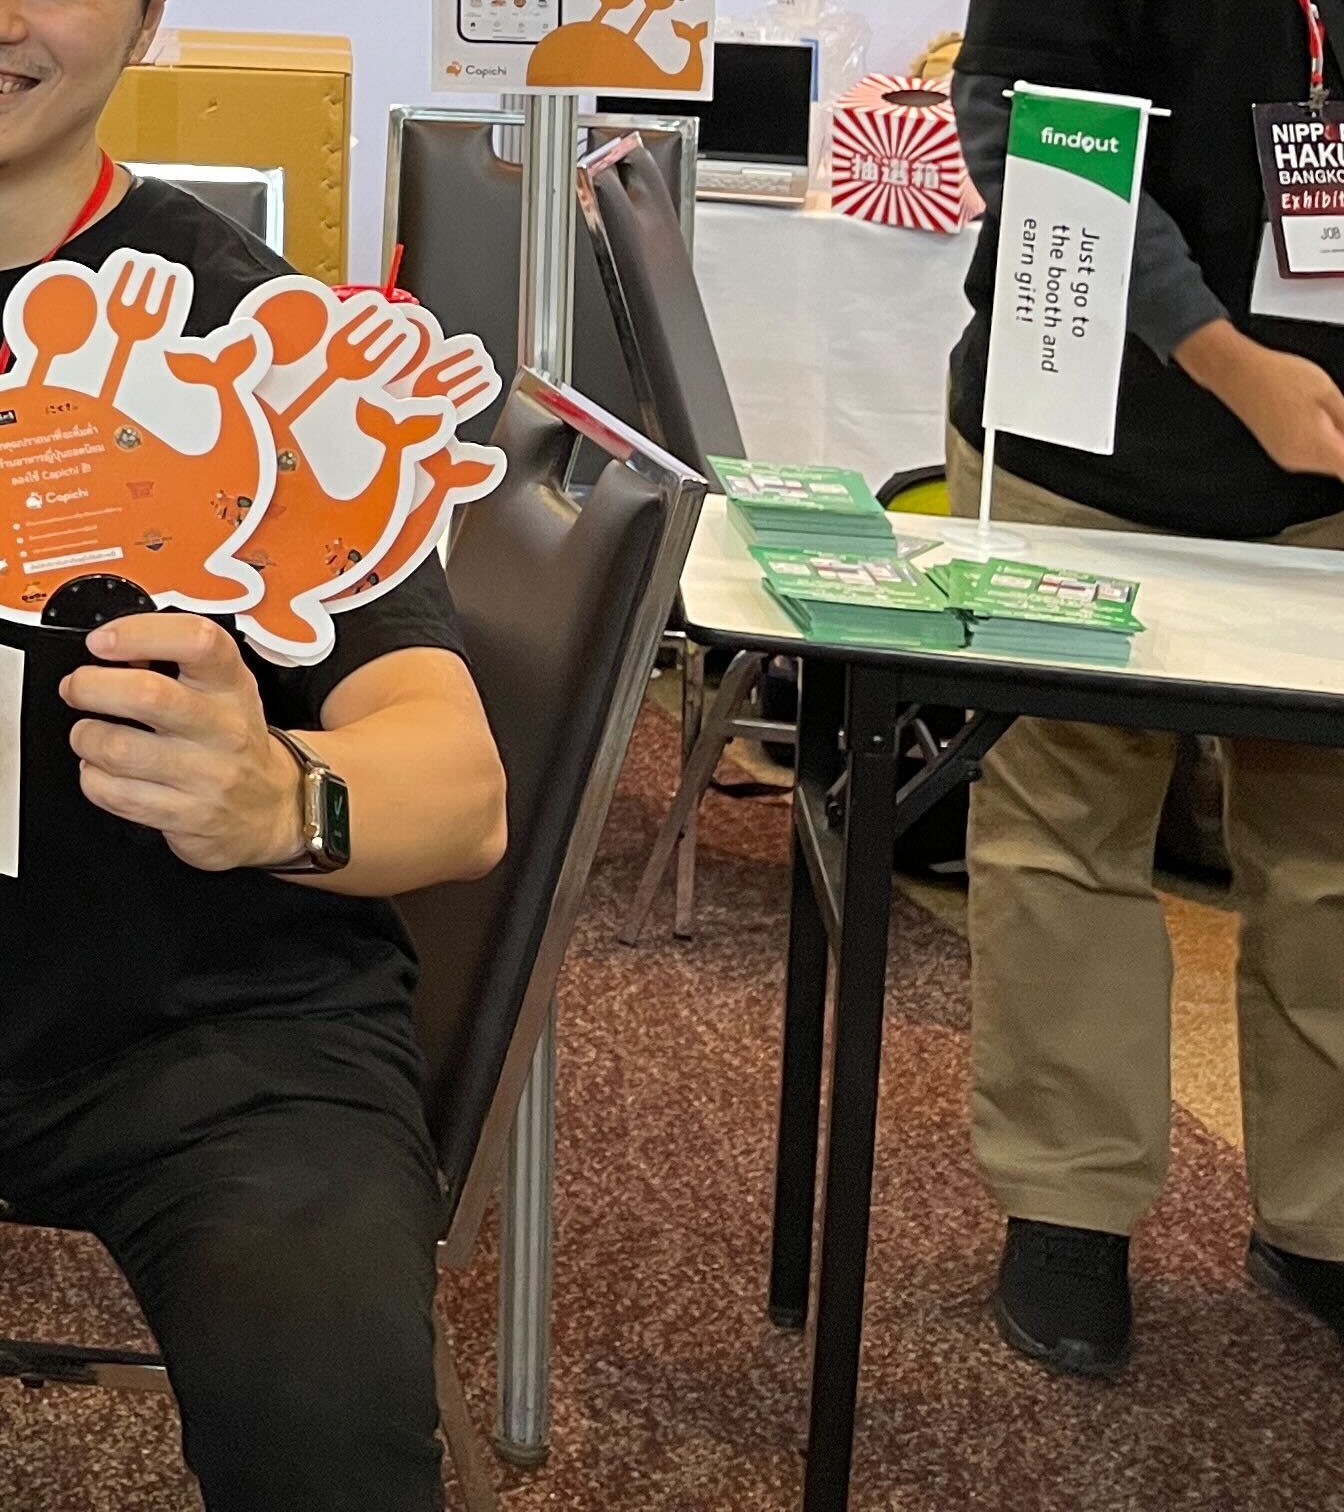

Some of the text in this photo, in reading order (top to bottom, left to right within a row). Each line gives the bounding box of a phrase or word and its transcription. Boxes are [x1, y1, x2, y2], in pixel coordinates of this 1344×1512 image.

[465, 65, 507, 79] Capichi
[1041, 126, 1118, 153] findout
[1321, 227, 1341, 240] JOB
[1015, 218, 1039, 323] earn gift!
[1070, 227, 1098, 338] Just go to
[1041, 224, 1070, 373] the booth and
[46, 488, 89, 504] Capichi
